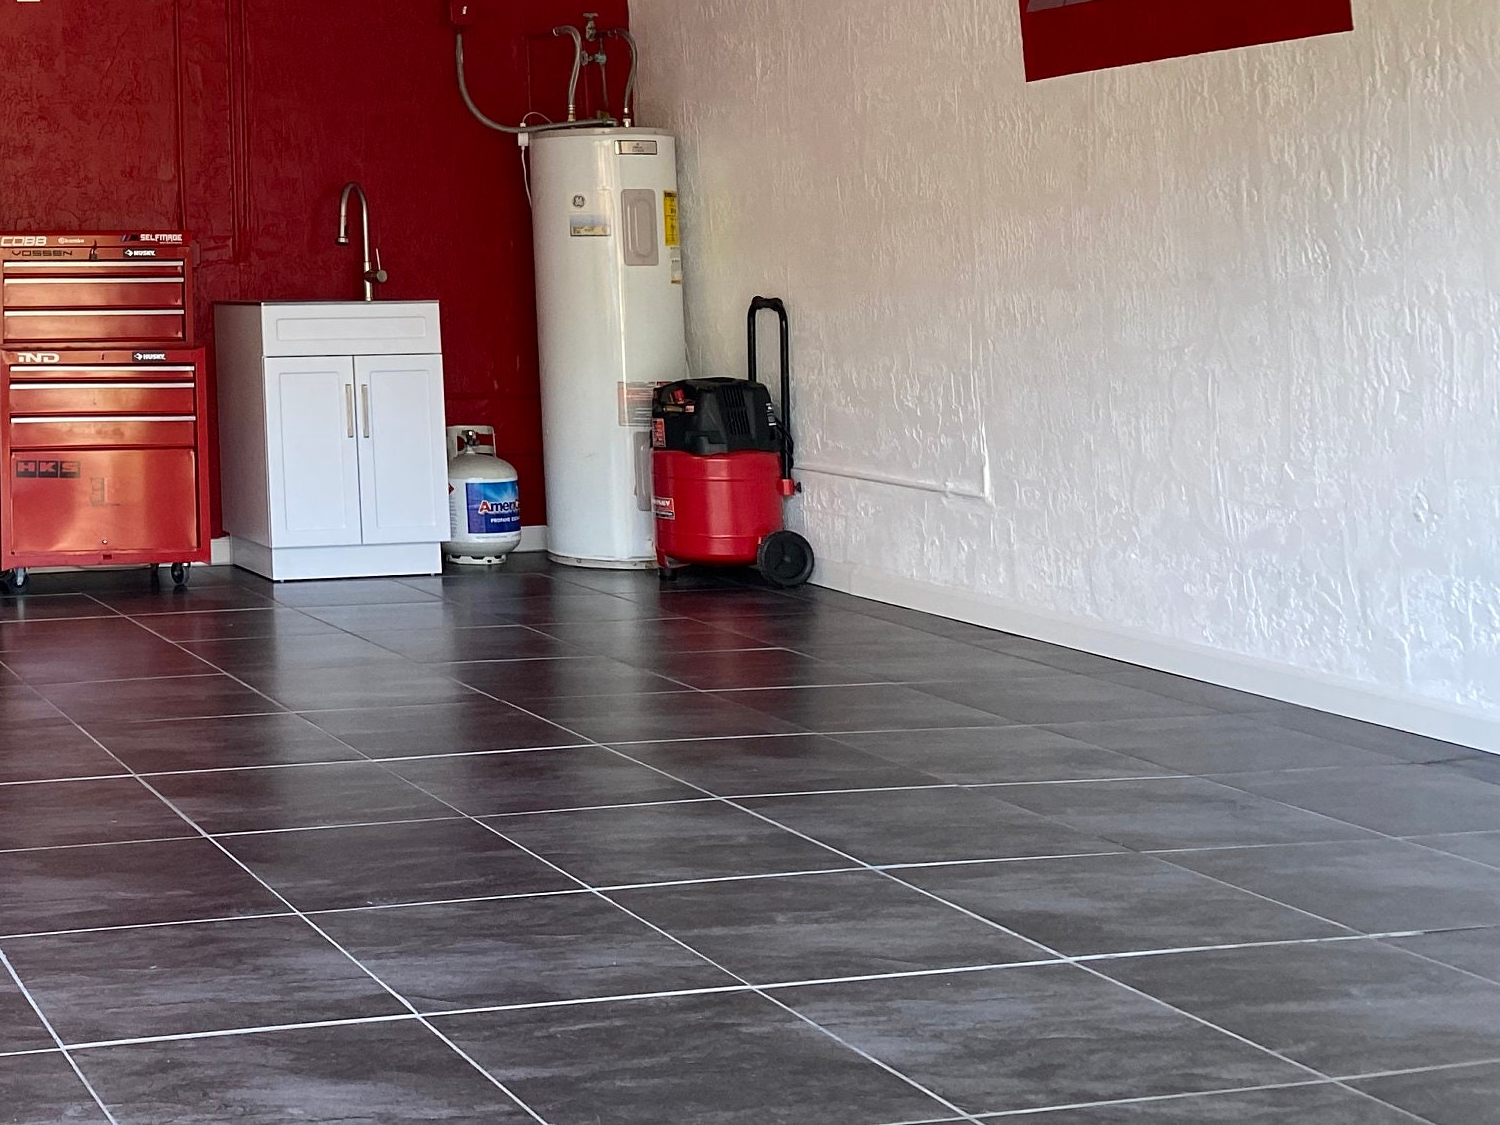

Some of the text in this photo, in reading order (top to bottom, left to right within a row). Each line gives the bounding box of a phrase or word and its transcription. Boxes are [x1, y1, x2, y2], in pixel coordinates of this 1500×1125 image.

[0, 236, 47, 247] COBB
[142, 353, 165, 361] HUSKY
[16, 461, 79, 475] HKS
